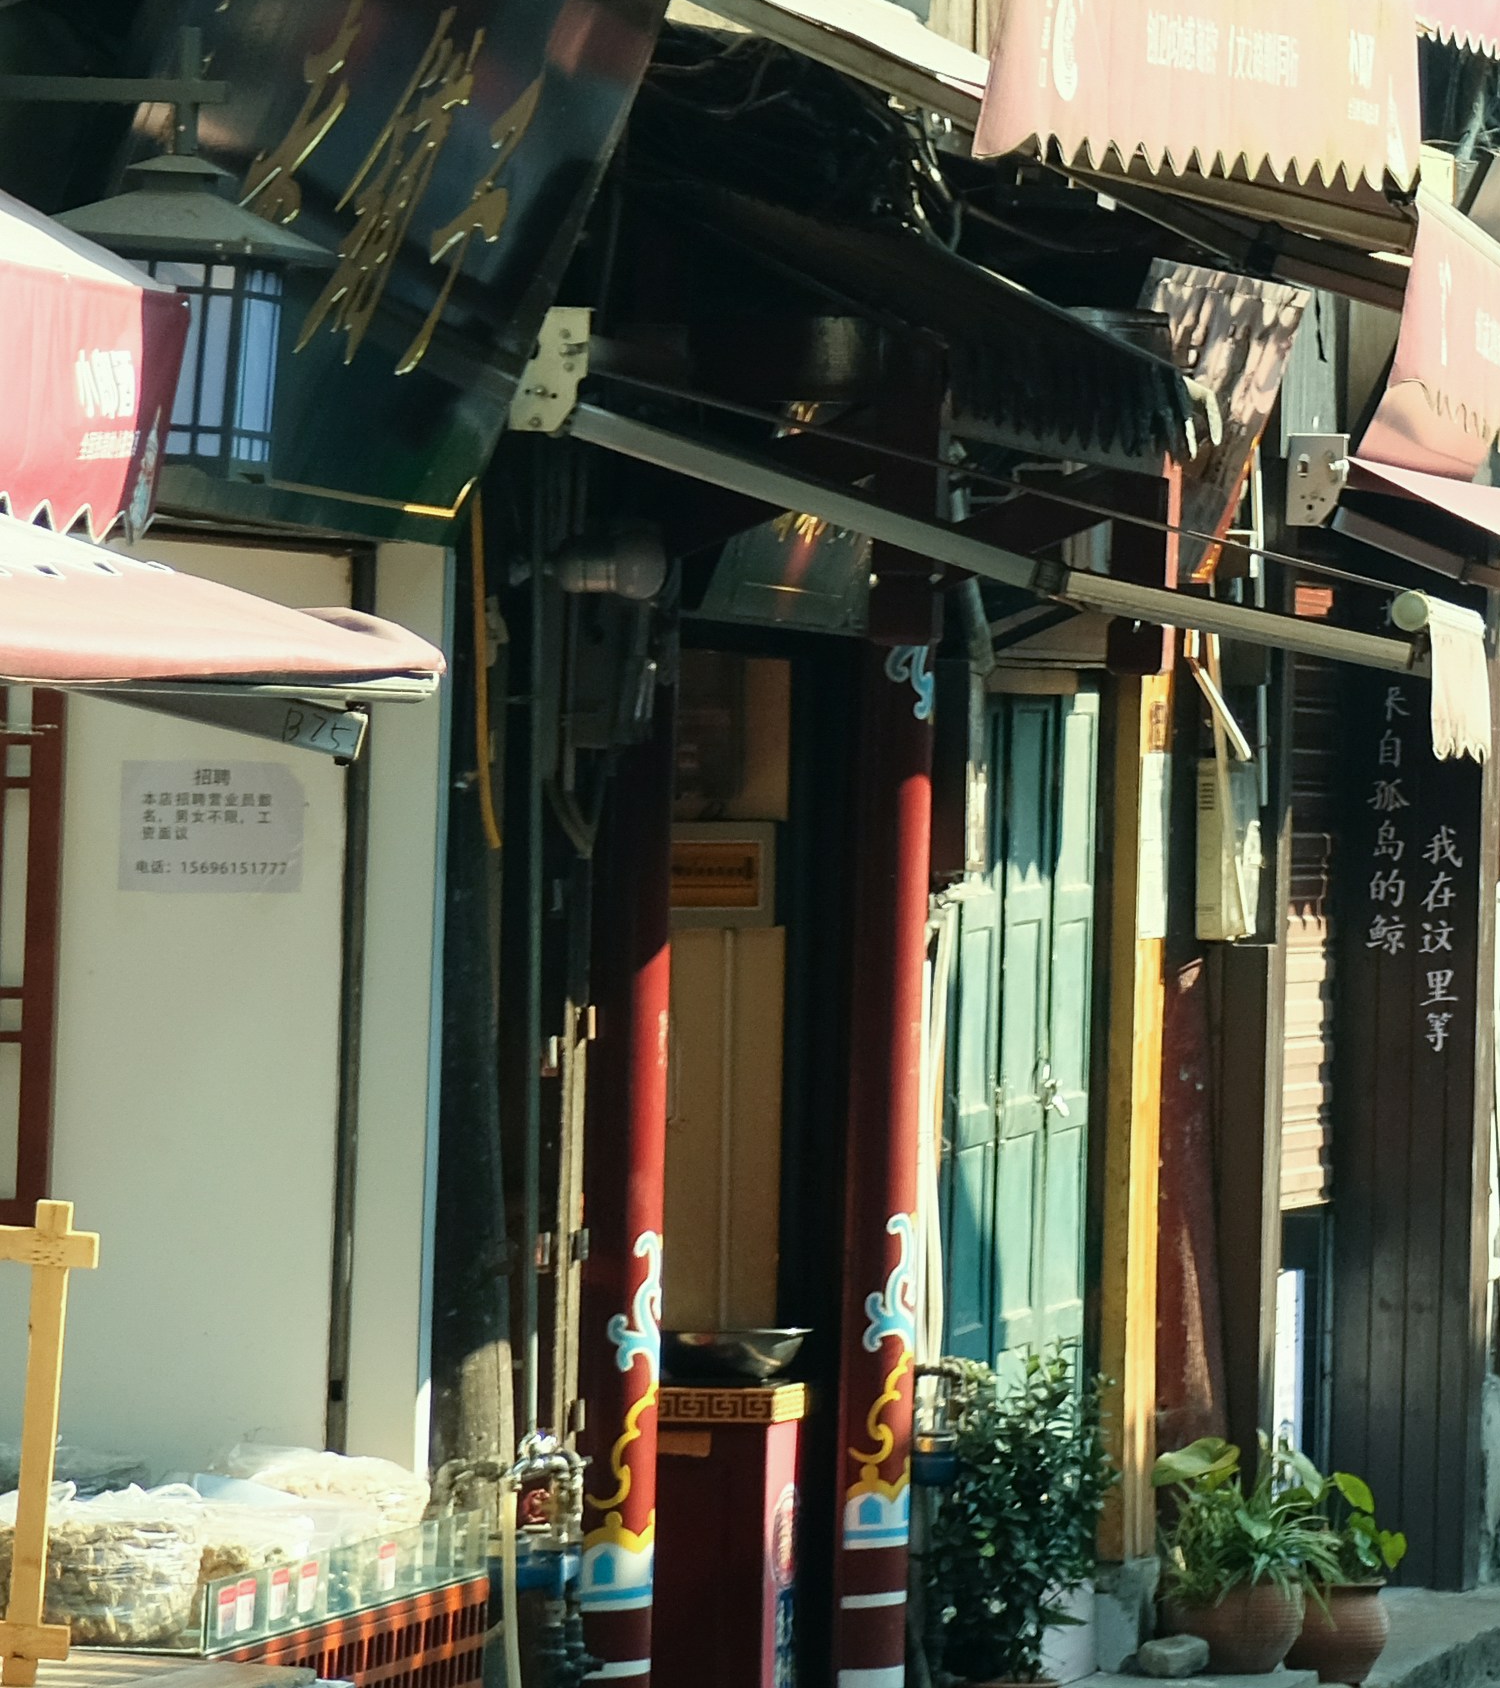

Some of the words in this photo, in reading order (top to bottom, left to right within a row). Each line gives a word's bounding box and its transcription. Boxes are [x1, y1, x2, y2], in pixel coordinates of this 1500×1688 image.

[193, 768, 231, 786] 招聘
[141, 826, 189, 840] 资面议
[1418, 824, 1464, 1054] 我在这里等
